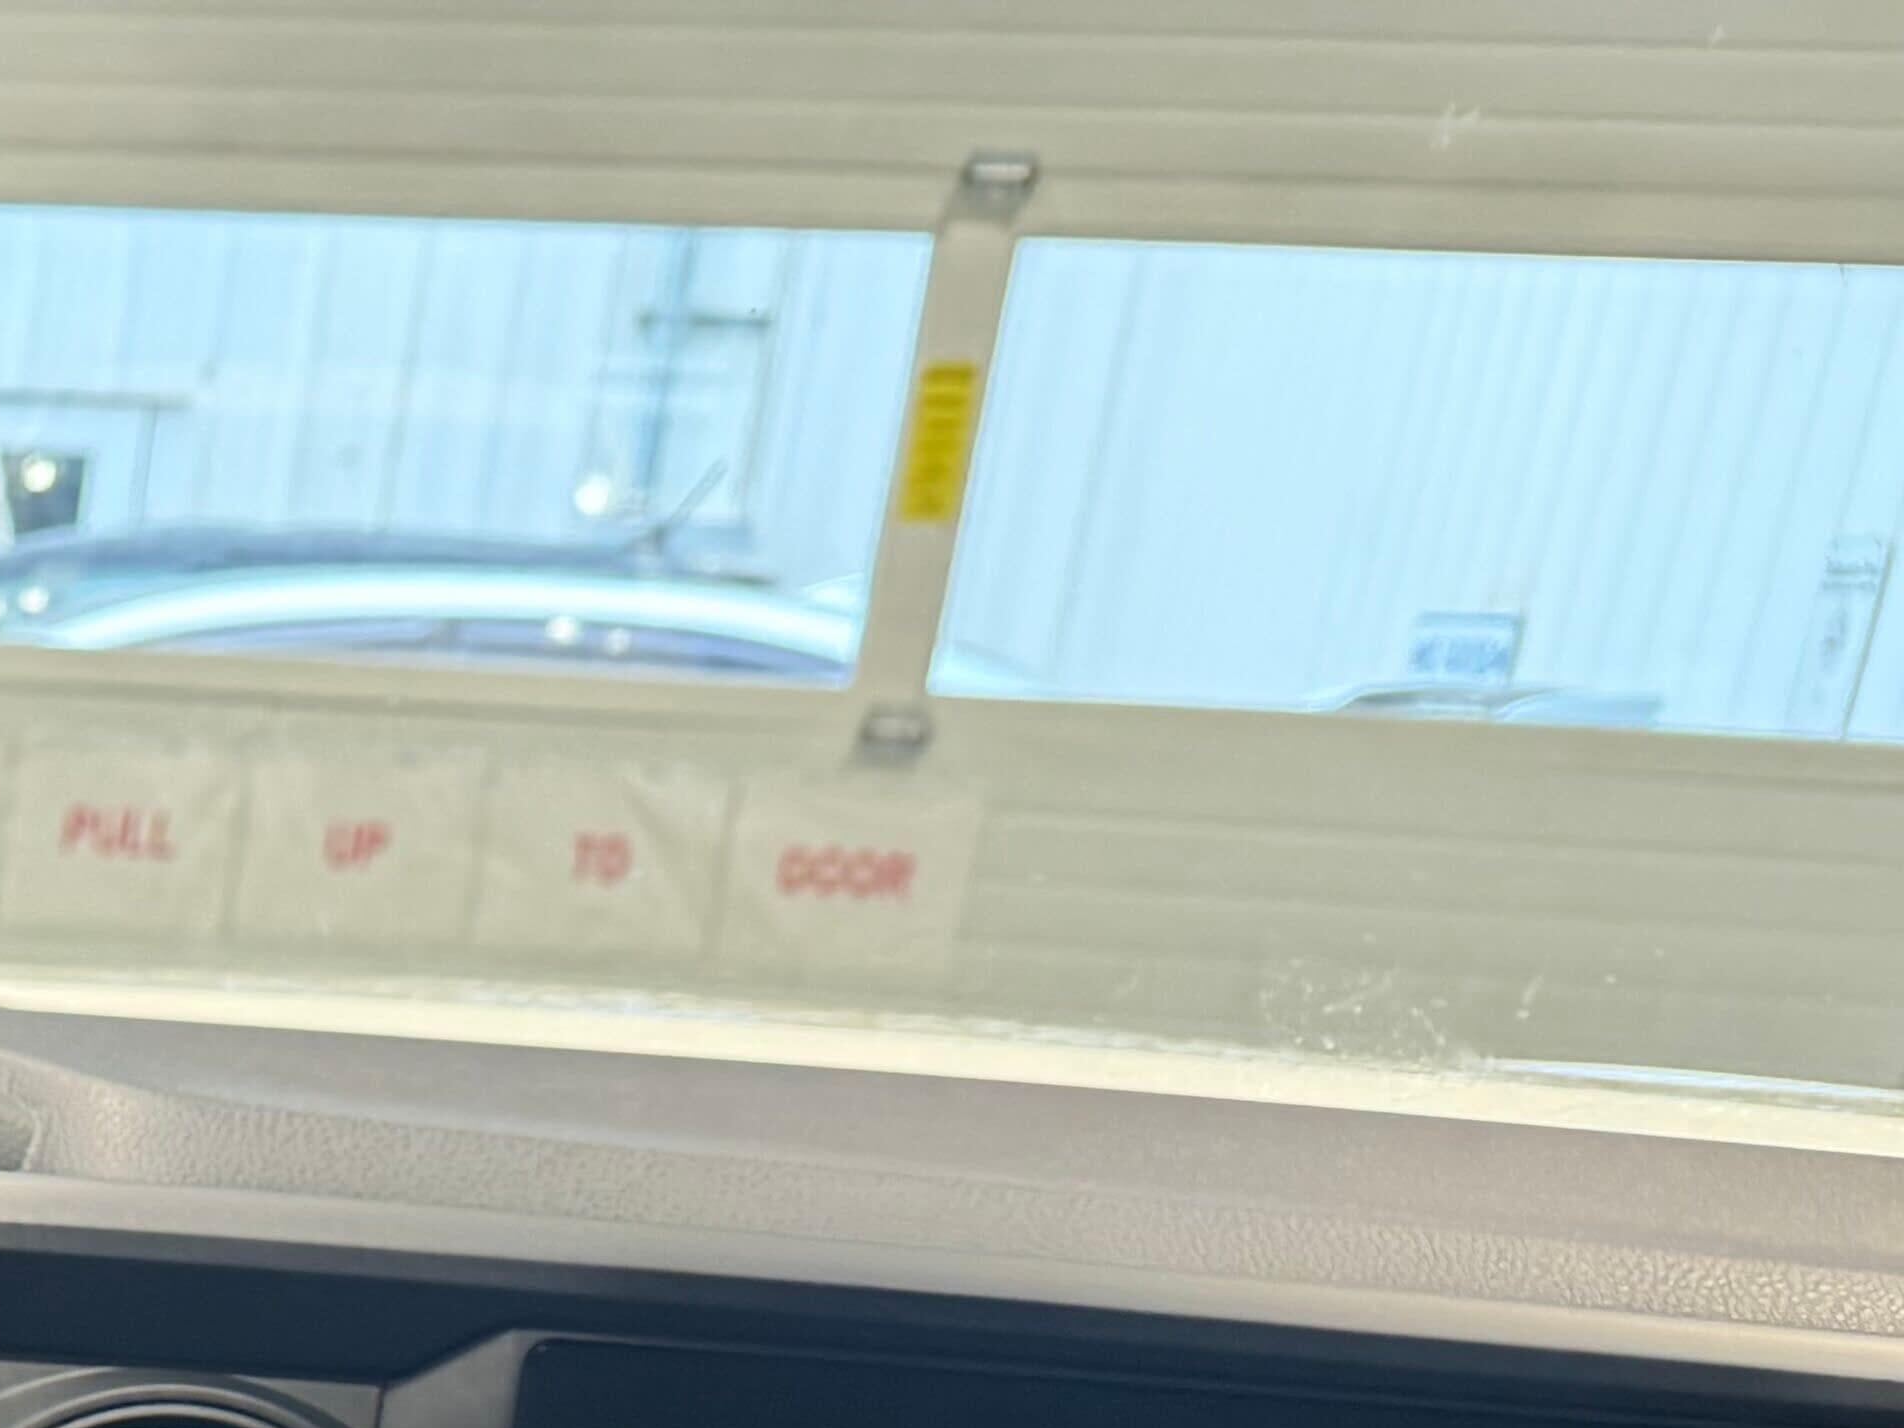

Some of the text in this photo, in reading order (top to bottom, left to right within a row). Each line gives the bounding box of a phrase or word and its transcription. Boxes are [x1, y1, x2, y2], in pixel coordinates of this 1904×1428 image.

[58, 801, 176, 862] PULL
[322, 818, 394, 870] UP
[572, 829, 634, 885] TO
[775, 845, 920, 902] DOOR
